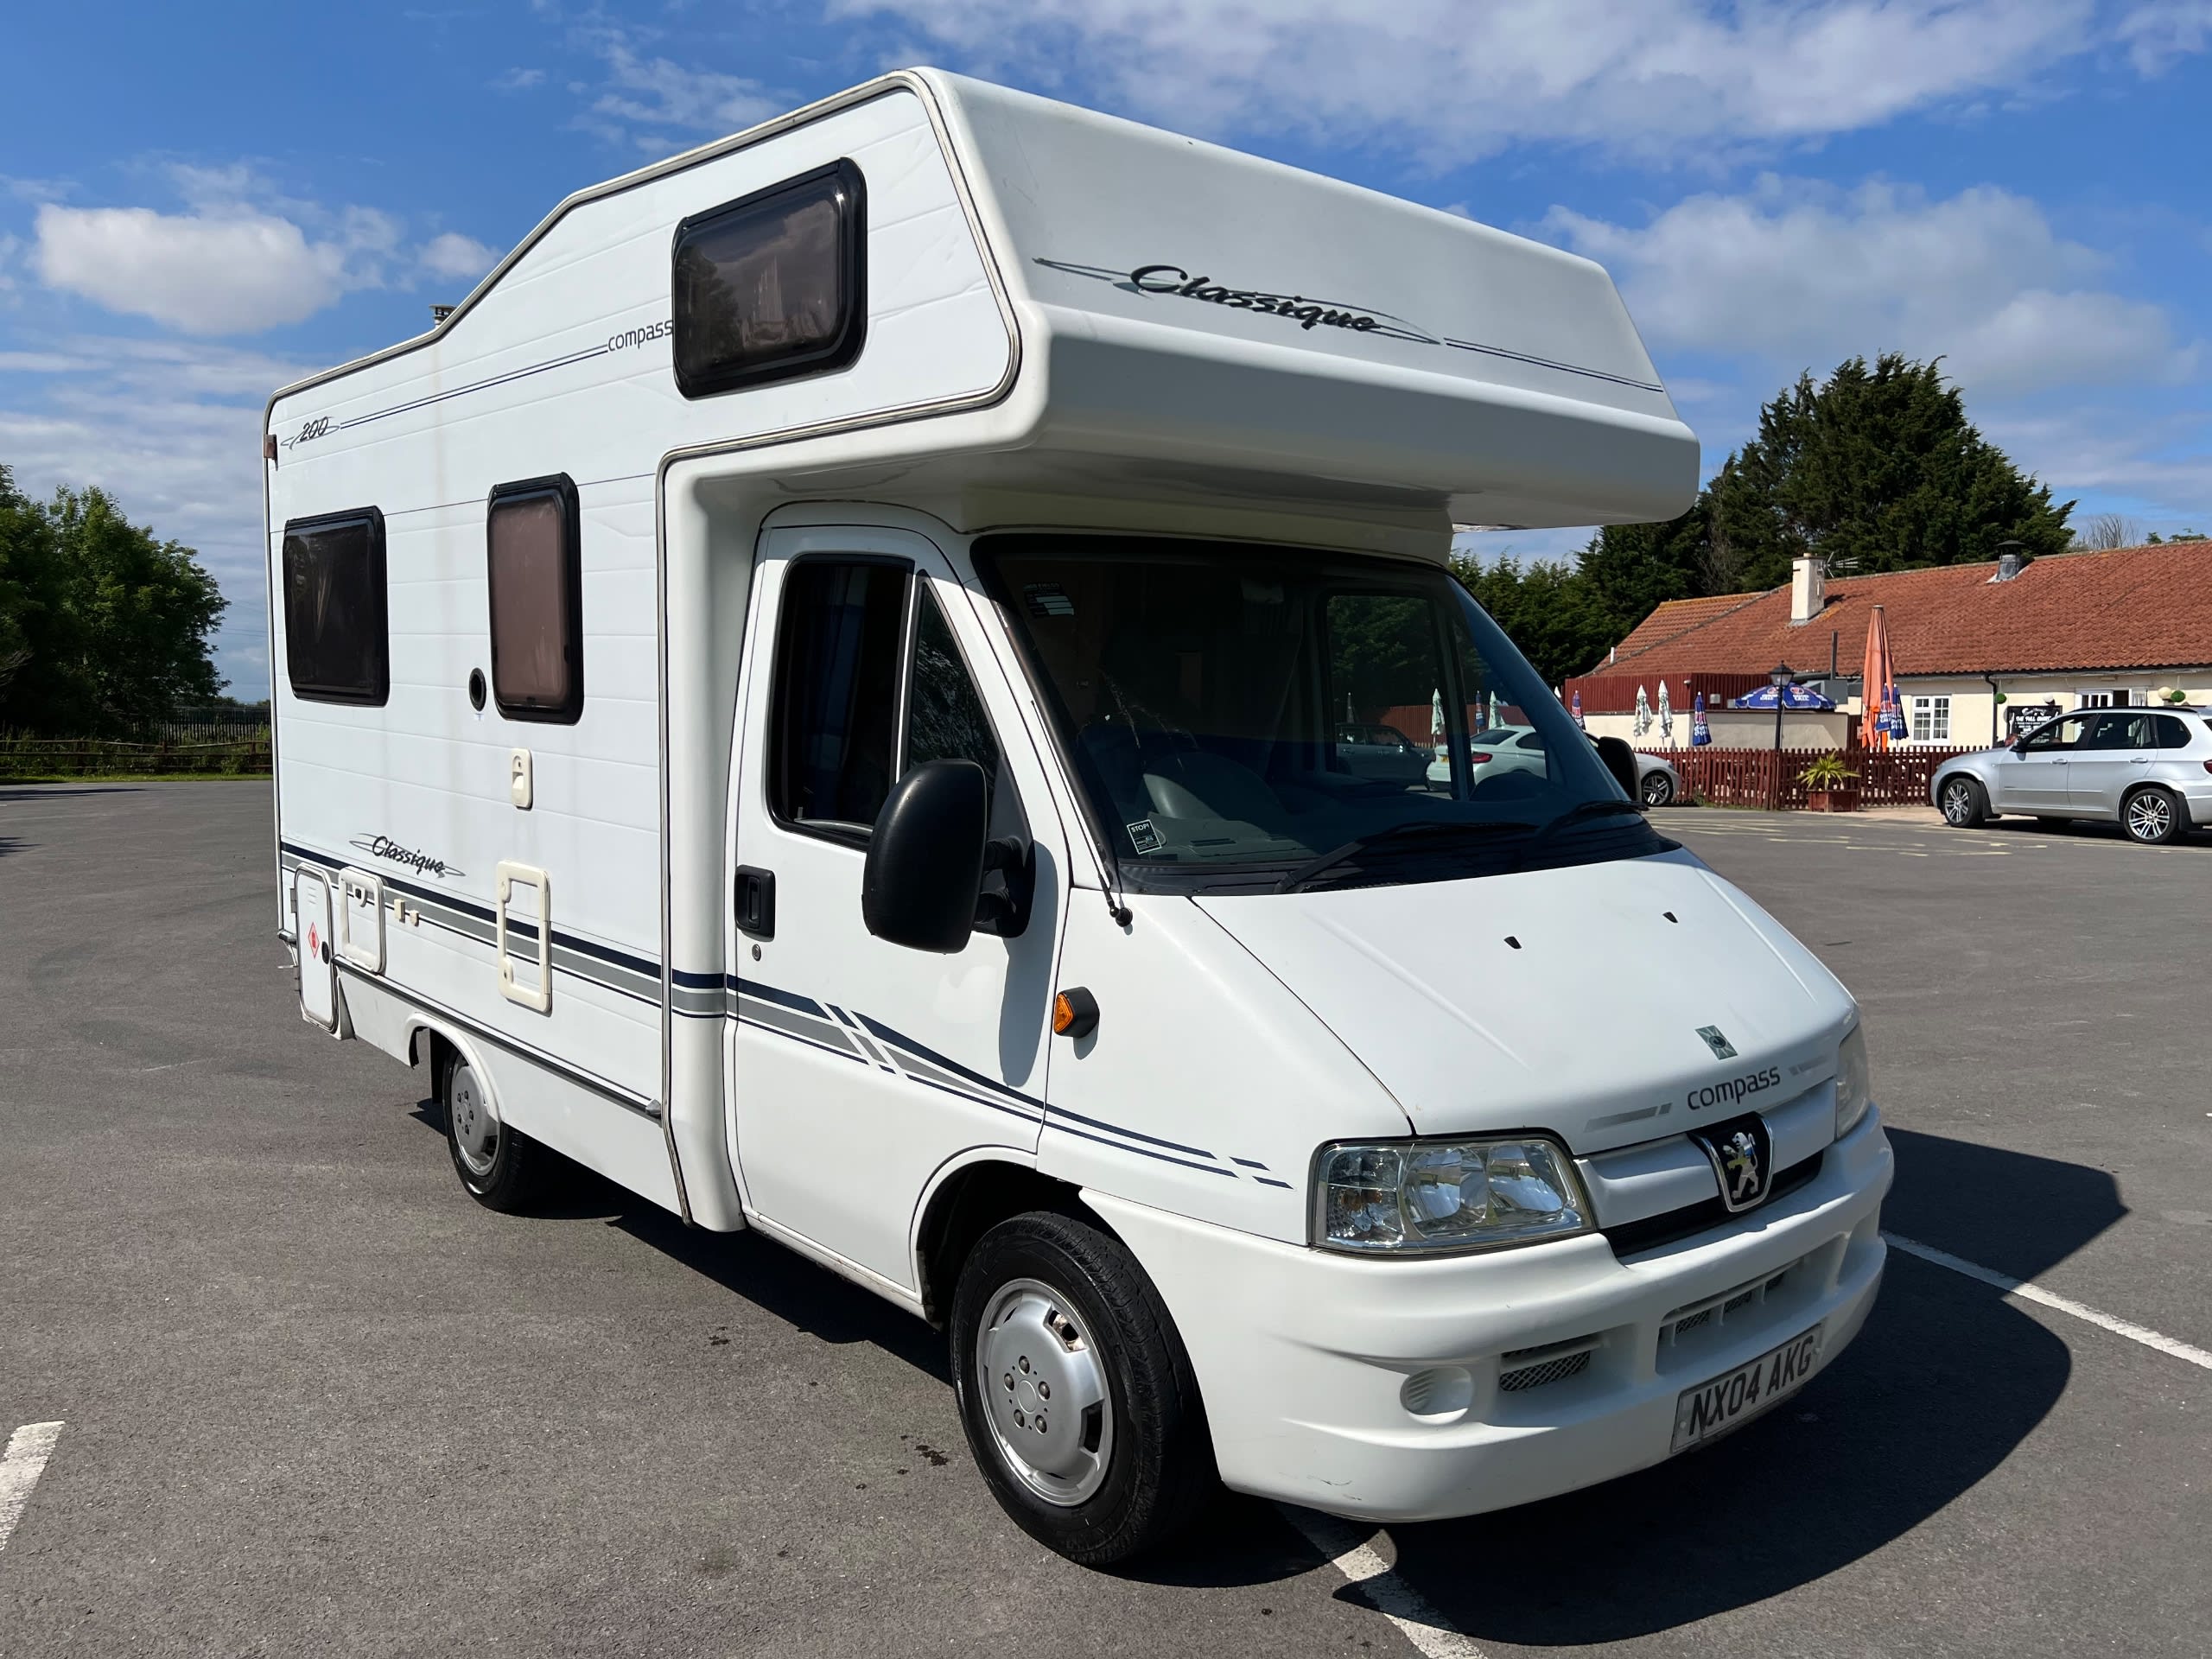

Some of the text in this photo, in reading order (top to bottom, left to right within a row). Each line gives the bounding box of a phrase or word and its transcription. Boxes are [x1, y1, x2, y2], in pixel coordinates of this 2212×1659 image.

[1130, 264, 1382, 330] Classique
[608, 319, 673, 352] compass
[299, 416, 329, 442] 200
[1131, 823, 1149, 832] STOP!
[372, 836, 446, 875] Classique
[1687, 1066, 1781, 1111] compass
[1688, 1335, 1814, 1436] NX04 AKG
